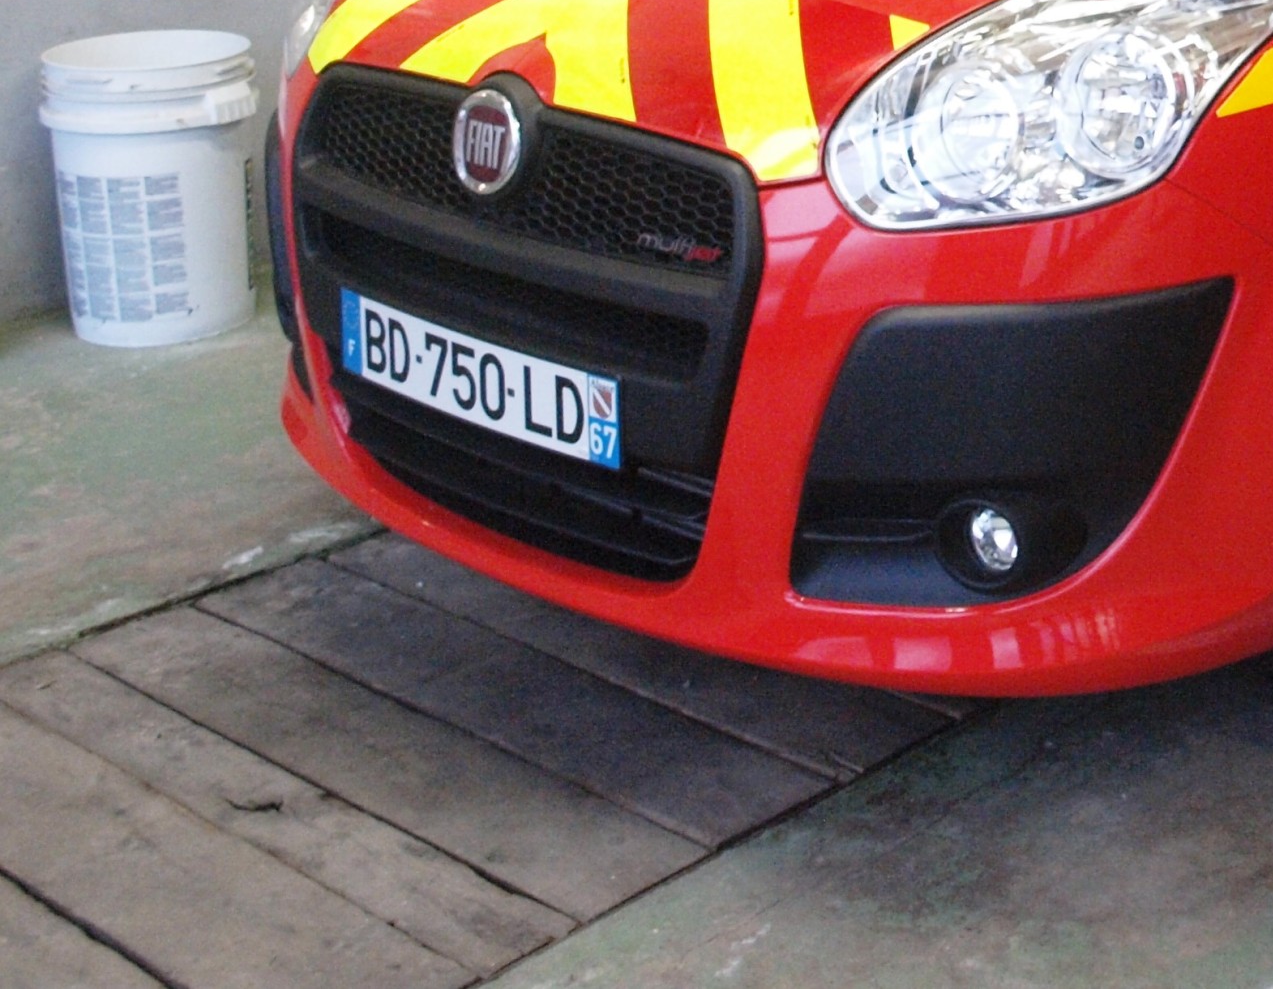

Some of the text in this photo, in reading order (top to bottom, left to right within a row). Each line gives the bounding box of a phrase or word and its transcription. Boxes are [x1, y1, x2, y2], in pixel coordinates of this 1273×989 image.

[466, 119, 505, 170] FIAT
[347, 338, 356, 357] F
[365, 308, 585, 444] BD-750-LD
[589, 422, 618, 460] 67
